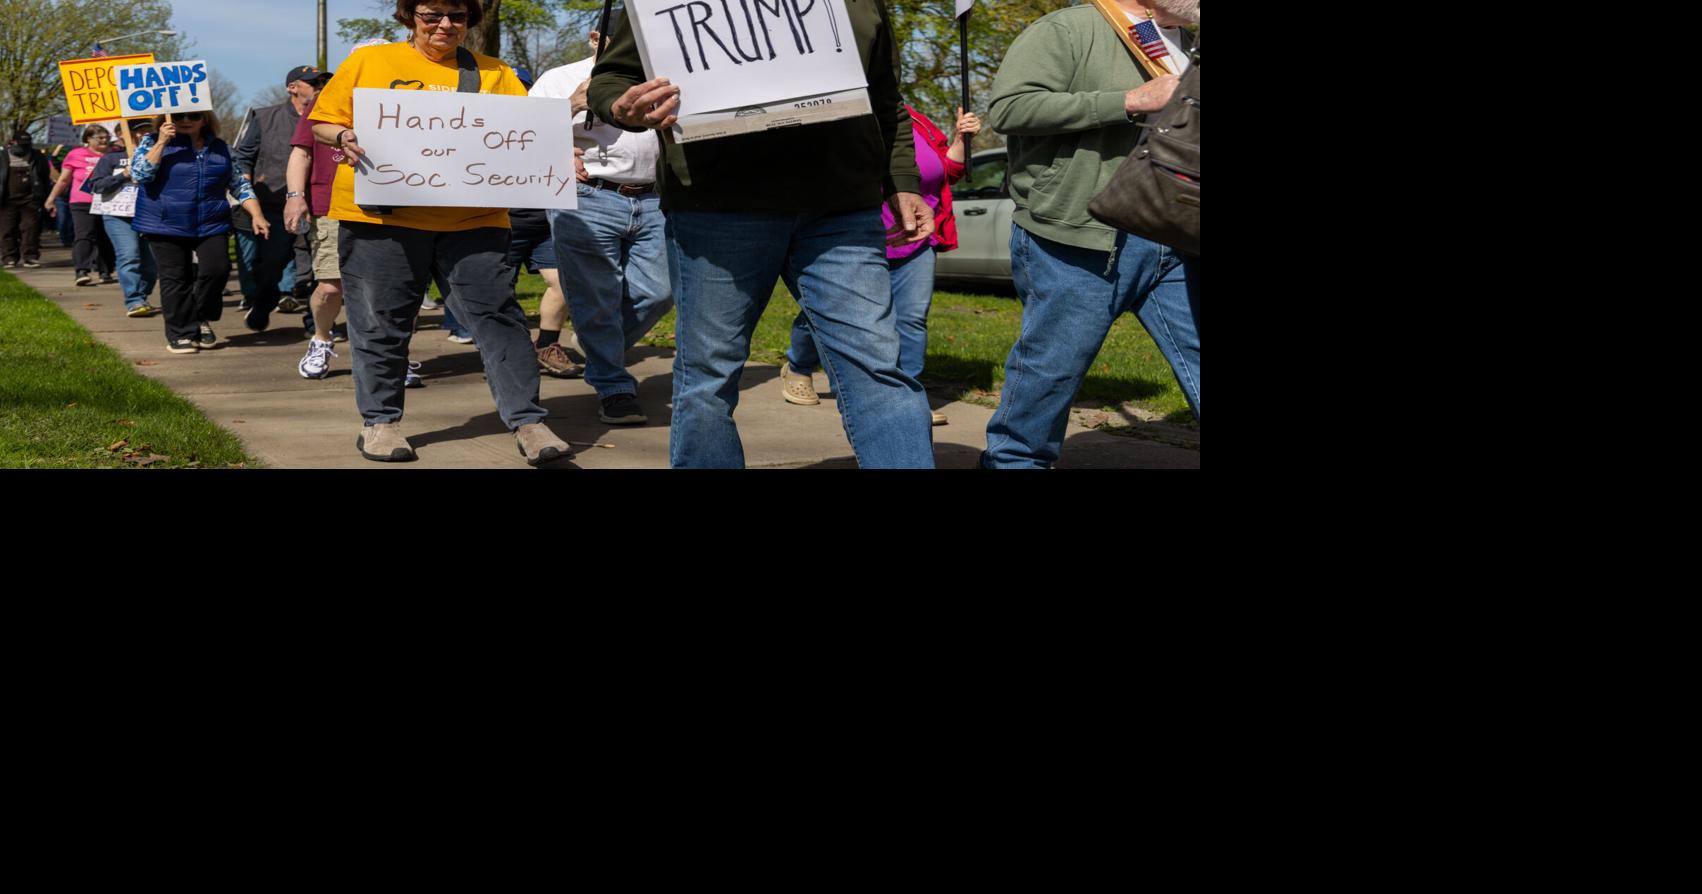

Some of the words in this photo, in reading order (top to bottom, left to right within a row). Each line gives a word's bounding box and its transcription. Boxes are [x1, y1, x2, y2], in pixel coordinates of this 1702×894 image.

[119, 63, 206, 90] HANDS
[73, 90, 119, 114] TRU
[377, 103, 485, 130] Hands
[483, 130, 536, 150] Off
[421, 147, 456, 157] our
[462, 162, 569, 196] Security
